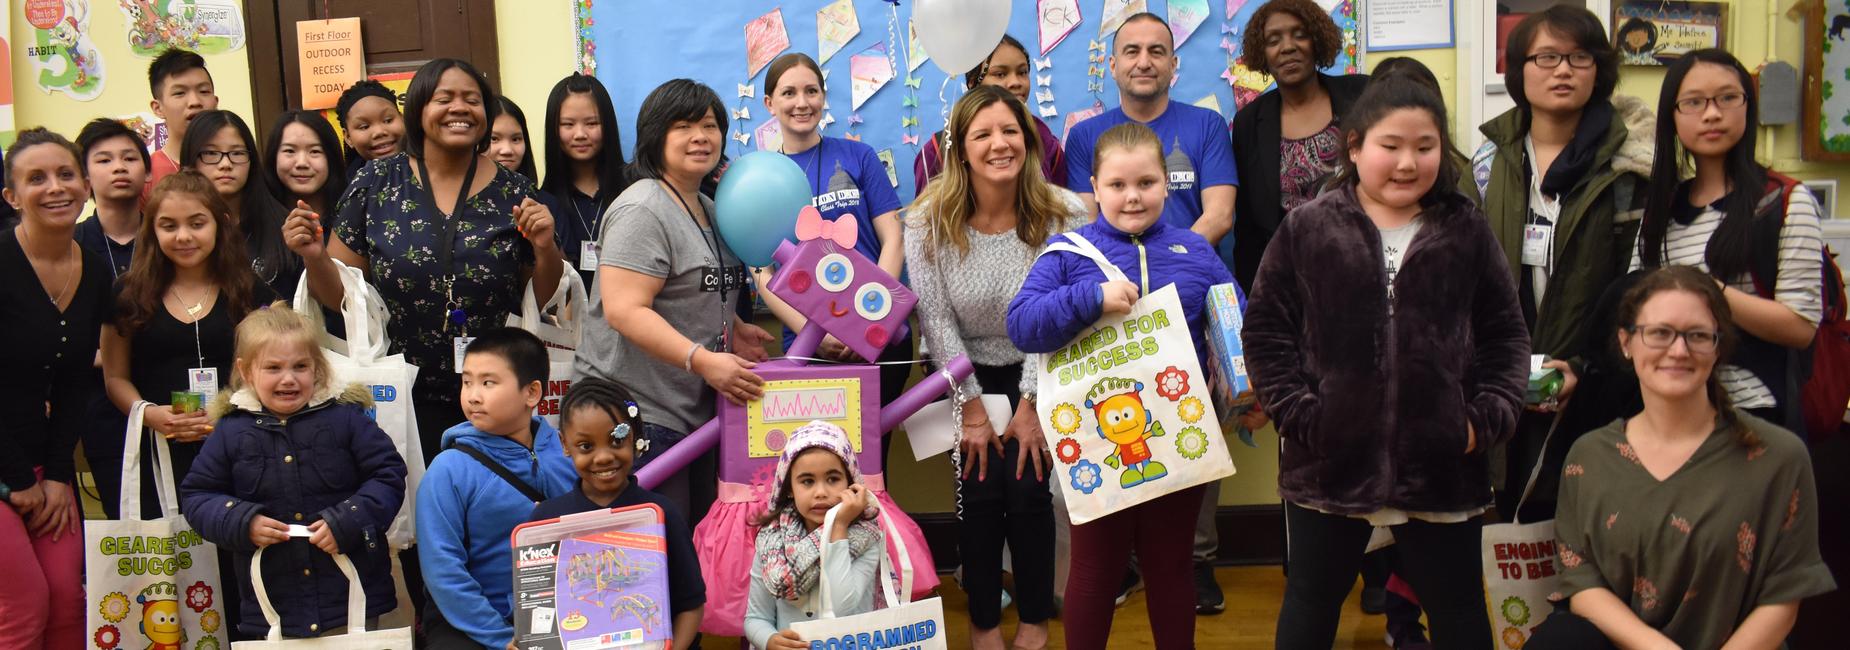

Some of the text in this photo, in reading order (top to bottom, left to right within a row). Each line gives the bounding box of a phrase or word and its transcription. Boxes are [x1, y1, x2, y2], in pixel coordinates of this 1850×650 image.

[305, 31, 351, 41] First Floor
[28, 46, 57, 57] HABIT
[305, 48, 351, 59] OUTDOOR
[313, 65, 345, 75] RECESS
[314, 83, 345, 93] TODAY
[704, 274, 719, 286] Co
[724, 273, 734, 284] Fe
[1122, 308, 1170, 339] FOR
[1058, 336, 1159, 386] SUCCESS
[100, 536, 176, 556] GEARE
[1494, 540, 1557, 560] ENGIN
[1498, 560, 1556, 580] TO BE
[810, 618, 937, 650] ROGRAMMED
